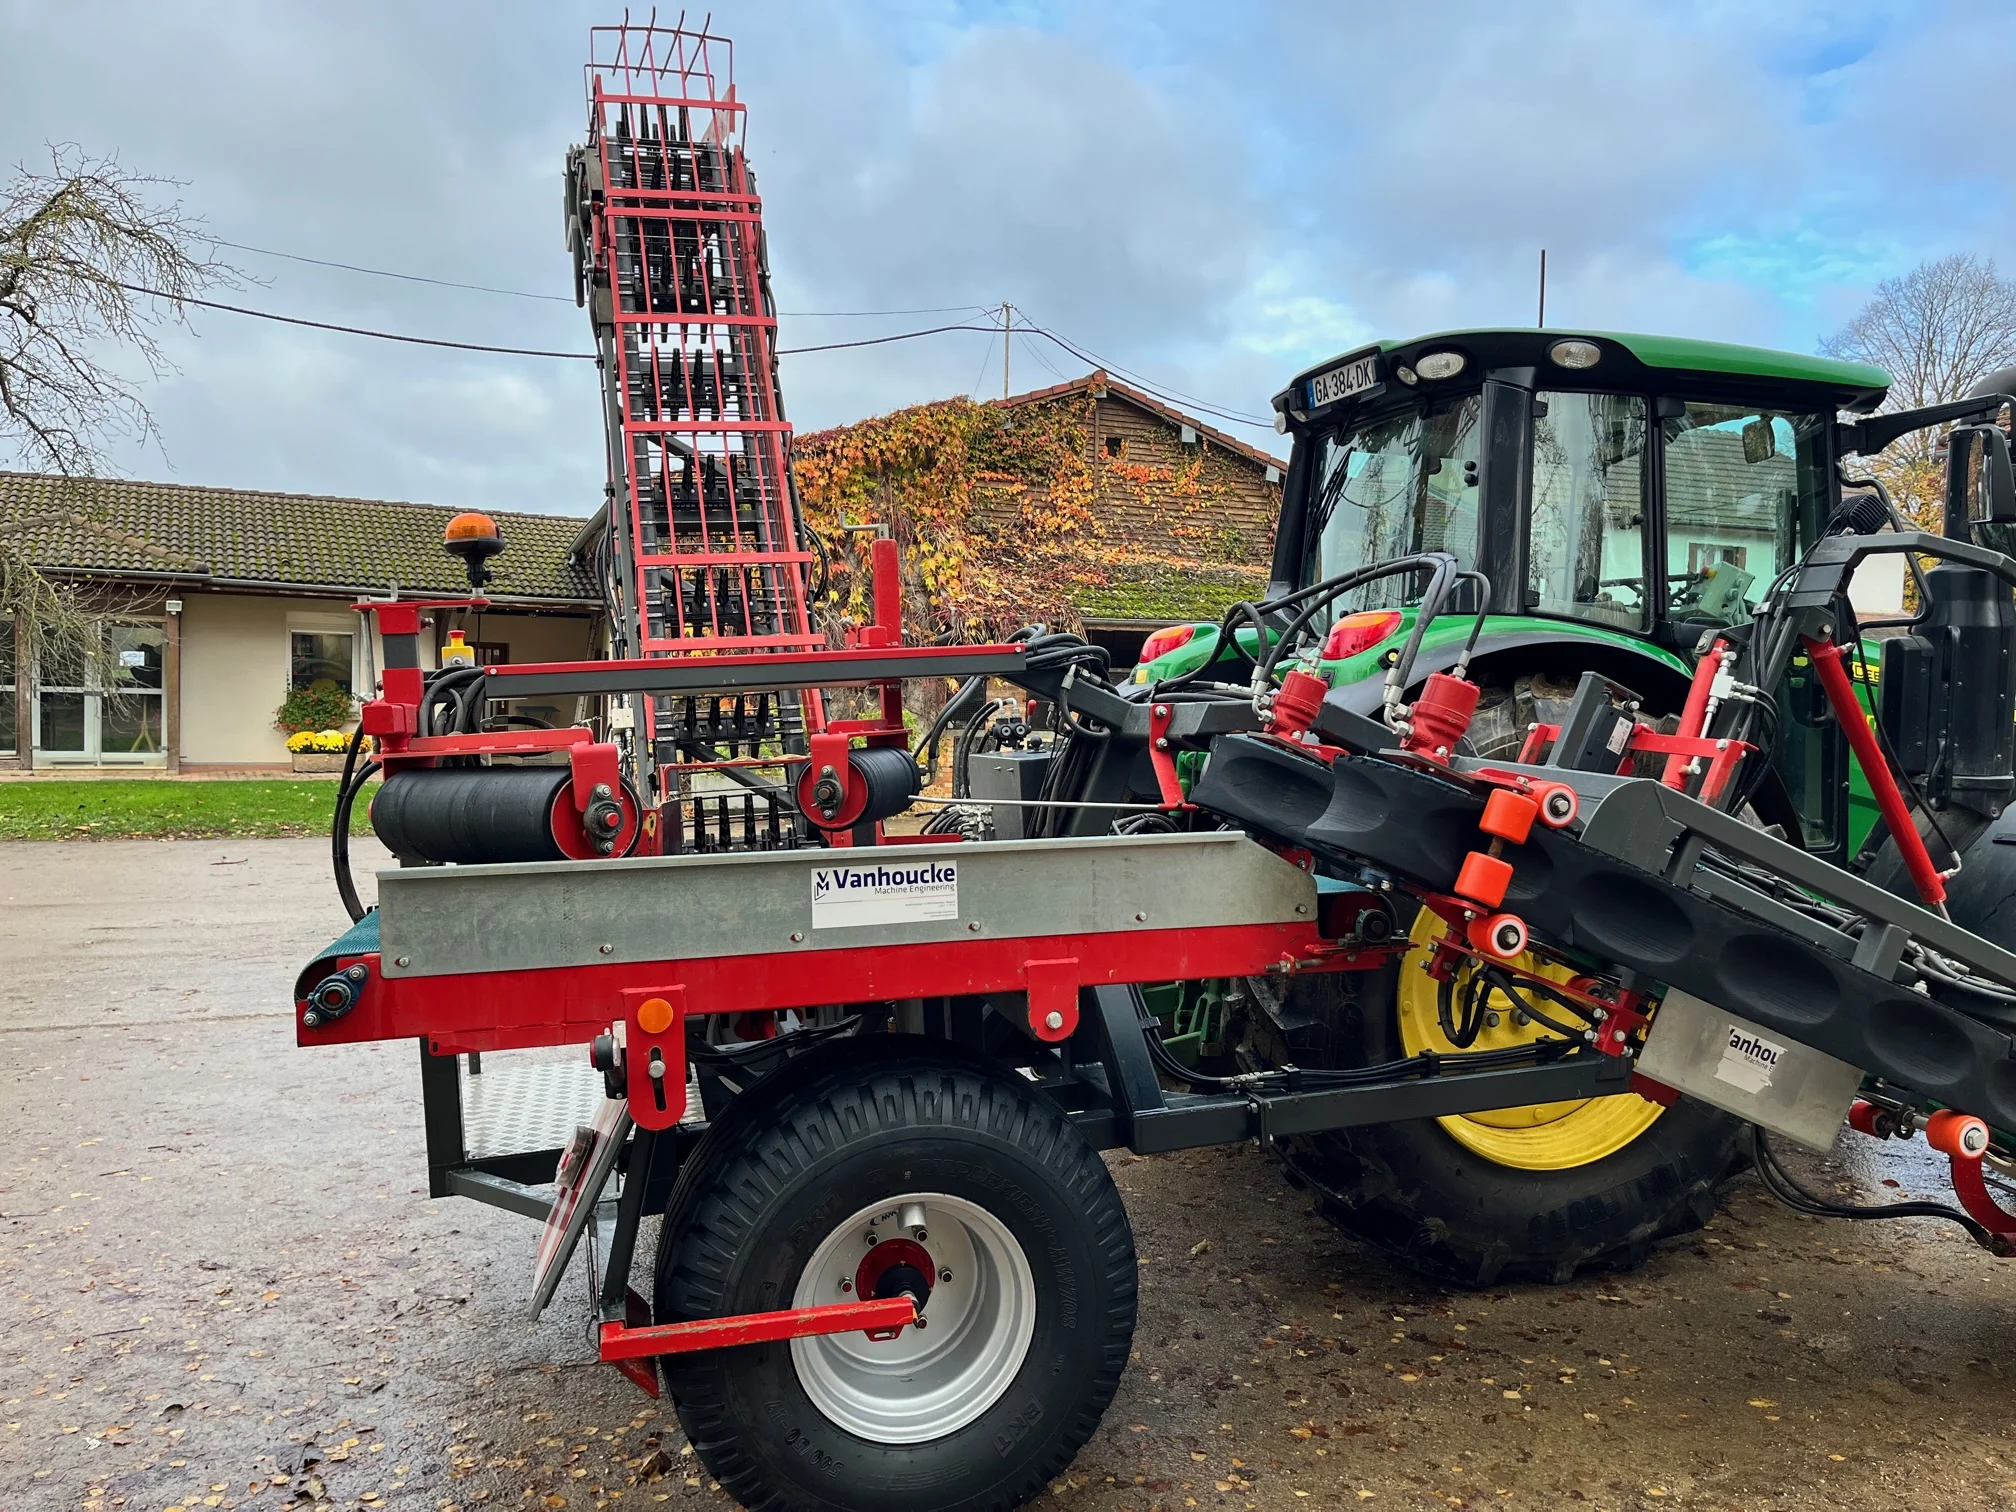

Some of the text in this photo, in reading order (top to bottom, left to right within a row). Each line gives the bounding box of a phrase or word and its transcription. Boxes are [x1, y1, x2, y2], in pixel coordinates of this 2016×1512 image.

[1314, 360, 1372, 403] GA-384-DK
[832, 863, 955, 889] Vanhoucke
[874, 883, 955, 895] Machine Engineering
[1729, 1028, 1777, 1065] anhou
[1743, 1054, 1769, 1070] Machine
